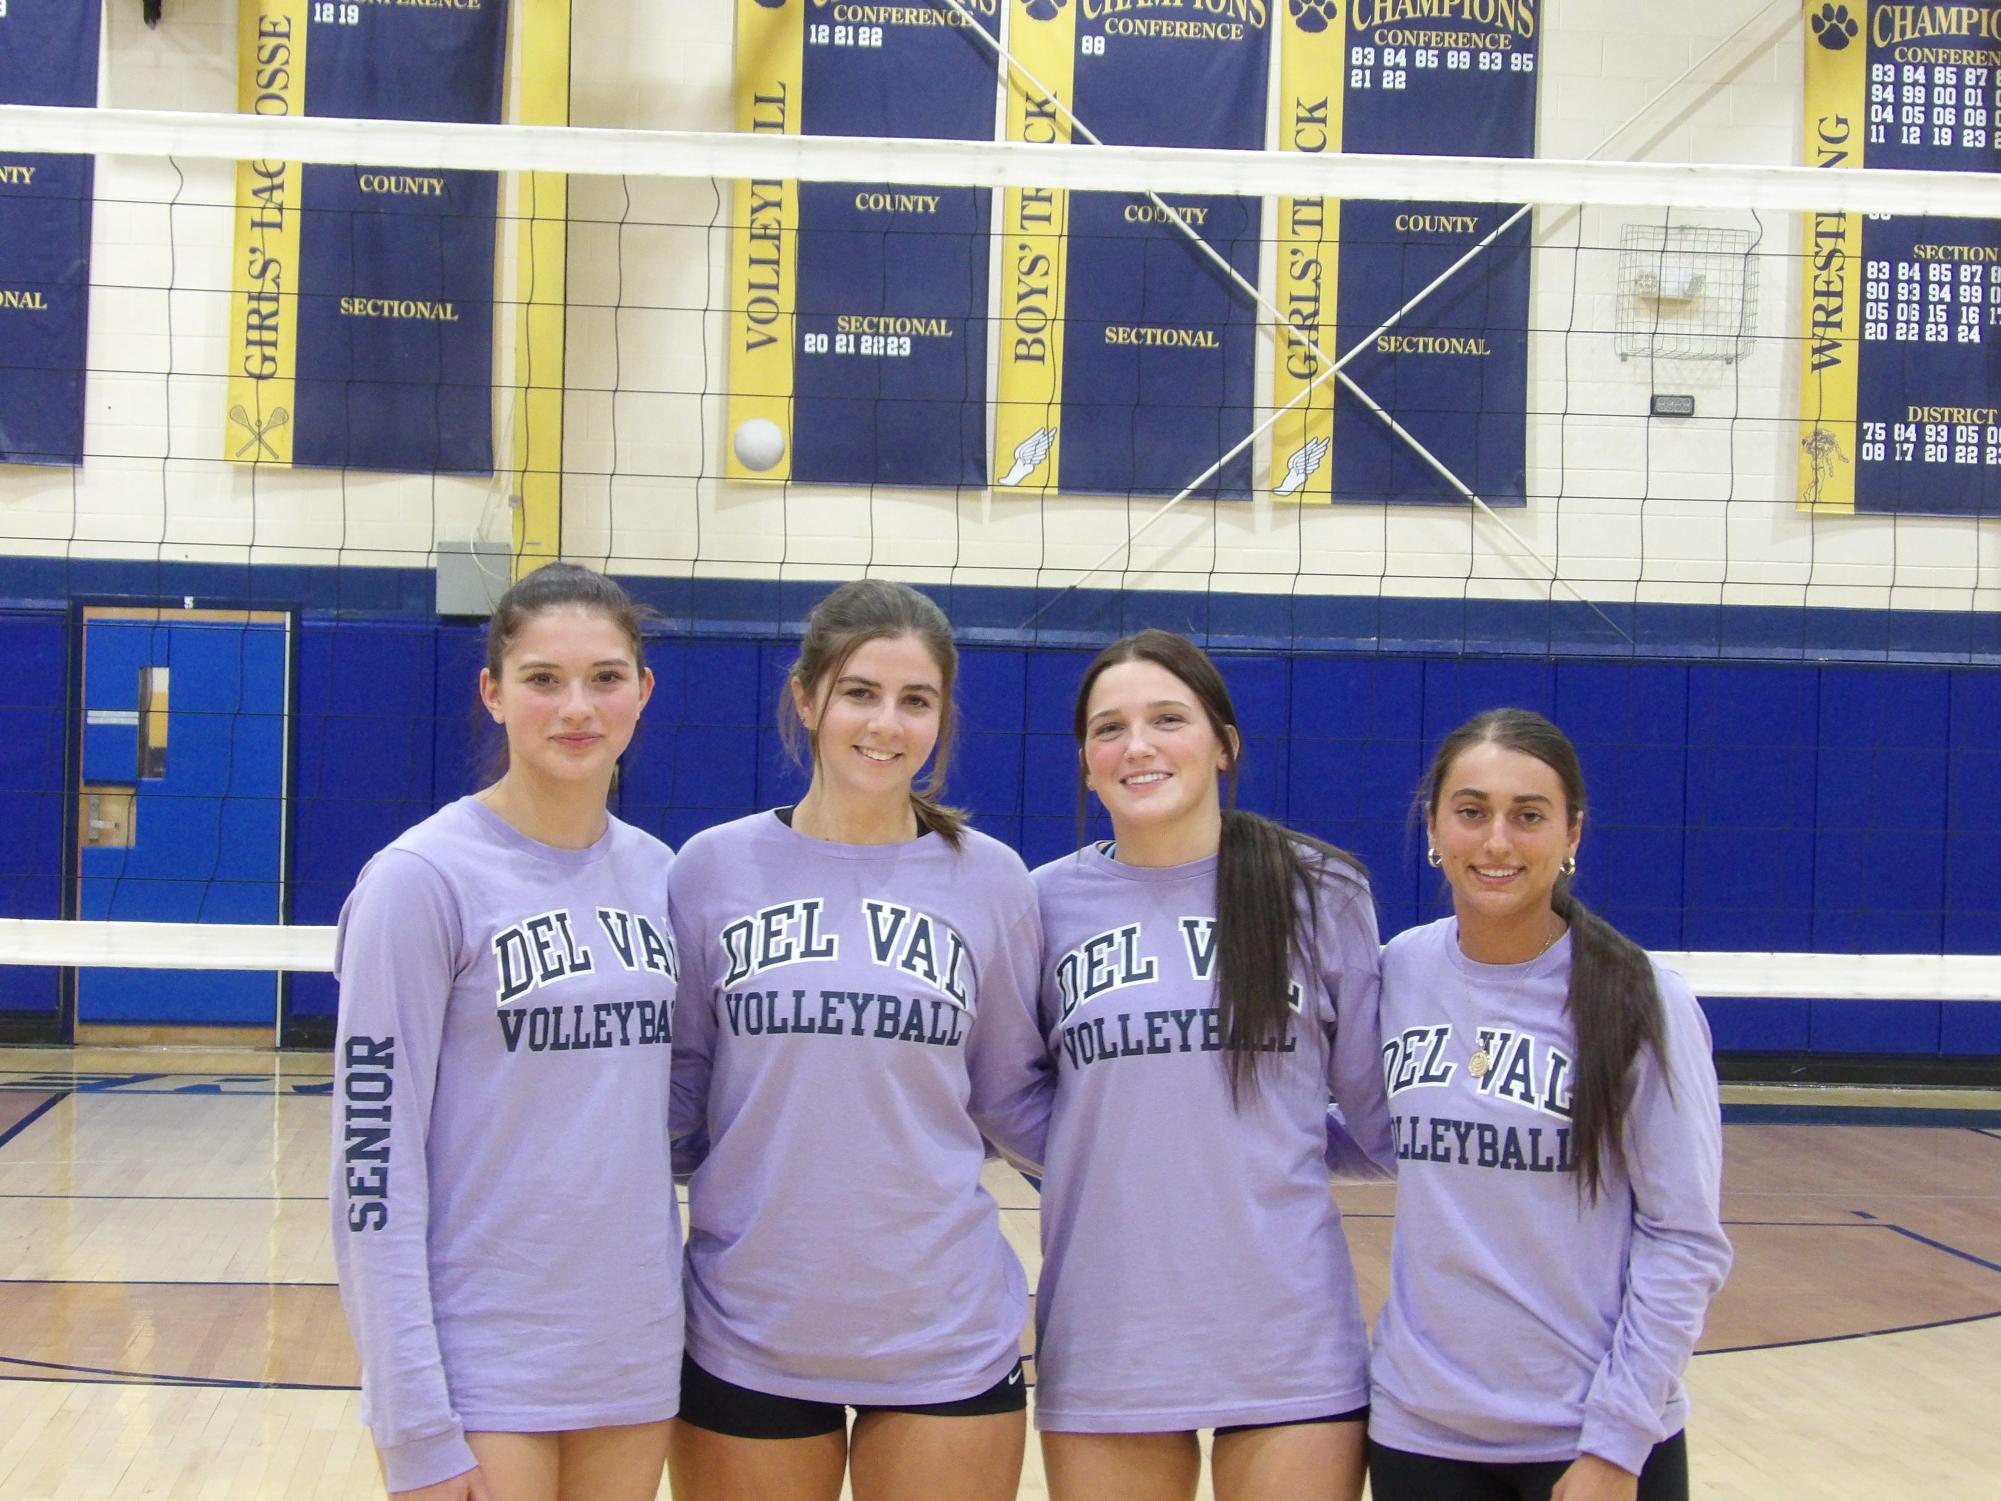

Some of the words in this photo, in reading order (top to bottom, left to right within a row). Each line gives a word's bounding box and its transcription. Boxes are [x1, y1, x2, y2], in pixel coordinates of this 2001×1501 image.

[314, 2, 335, 24] 12
[338, 4, 359, 25] 19
[809, 24, 830, 46] 12
[834, 25, 854, 47] 21
[858, 26, 883, 48] 22
[1104, 17, 1244, 40] CONFERENCE
[1374, 28, 1512, 50] CONFERENCE
[1081, 35, 1106, 55] 88
[1351, 47, 1375, 66] 83
[1383, 47, 1407, 67] 84
[1415, 49, 1439, 69] 85
[1447, 50, 1470, 70] 89
[1479, 51, 1502, 71] 93
[1511, 52, 1534, 72] 95
[1351, 69, 1371, 88] 21
[1382, 70, 1406, 89] 22
[1872, 63, 1895, 82] 83
[1902, 65, 1926, 84] 84
[1934, 67, 1957, 85] 85
[1964, 68, 1988, 87] 87
[1871, 84, 1895, 103] 94
[1902, 85, 1926, 104] 99
[1933, 87, 1956, 105] 00
[1964, 88, 1983, 107] 01
[251, 14, 292, 233] LACOSSE
[1870, 104, 1894, 123] 04
[1902, 106, 1925, 124] 05
[1933, 107, 1956, 126] 06
[1964, 108, 1987, 127] 08
[1870, 125, 1885, 143] 11
[1901, 126, 1921, 145] 12
[1933, 127, 1952, 146] 19
[1962, 129, 1986, 148] 23
[1020, 90, 1058, 231] TCK
[1291, 95, 1328, 237] TCK
[359, 174, 445, 197] COUNTY
[855, 193, 940, 214] COUNTY
[746, 80, 786, 353] VOLLEYLL
[1395, 215, 1479, 234] COUNTY
[1811, 113, 1850, 374] WRESTNG
[1867, 261, 1889, 279] 83
[1898, 262, 1920, 280] 84
[1929, 264, 1951, 281] 85
[1960, 265, 1982, 283] 87
[0, 290, 48, 310] NAL
[1866, 282, 1889, 299] 90
[1897, 283, 1920, 301] 93
[1928, 284, 1951, 302] 94
[1959, 285, 1982, 303] 99
[243, 247, 282, 381] GIRLS'
[340, 297, 459, 322] SECTIONAL
[1014, 242, 1050, 367] BOYS'
[1286, 247, 1322, 380] GIRLS'
[1865, 302, 1888, 320] 05
[1896, 303, 1920, 321] 06
[1928, 304, 1947, 322] 15
[1961, 306, 1980, 324] 16
[837, 315, 953, 337] SECTIONAL
[1104, 326, 1219, 348] SECTIONAL
[1864, 322, 1888, 340] 20
[1895, 322, 1919, 341] 22
[1925, 324, 1948, 341] 23
[1957, 325, 1981, 343] 24
[804, 333, 828, 354] 20
[835, 334, 855, 354] 21
[1376, 336, 1491, 356] SECTIONAL
[1908, 406, 1998, 424] DISTRICT
[1862, 422, 1886, 440] 75
[1893, 423, 1917, 442] 84
[1925, 424, 1948, 443] 93
[1956, 425, 1979, 444] 05
[1862, 442, 1885, 461] 08
[1895, 443, 1914, 461] 17
[1924, 444, 1948, 462] 20
[1955, 445, 1978, 464] 22
[491, 908, 596, 1008] DEL
[720, 897, 839, 992] DEL
[862, 898, 970, 1011] VAL
[1055, 922, 1158, 1030] DEL
[497, 1000, 675, 1052] VOLLEYBA
[725, 990, 963, 1047] VOLLEYBALL
[1476, 1027, 1574, 1123] VAL
[345, 1036, 394, 1232] SENIOR
[1392, 1116, 1579, 1172] LLEYBALL
